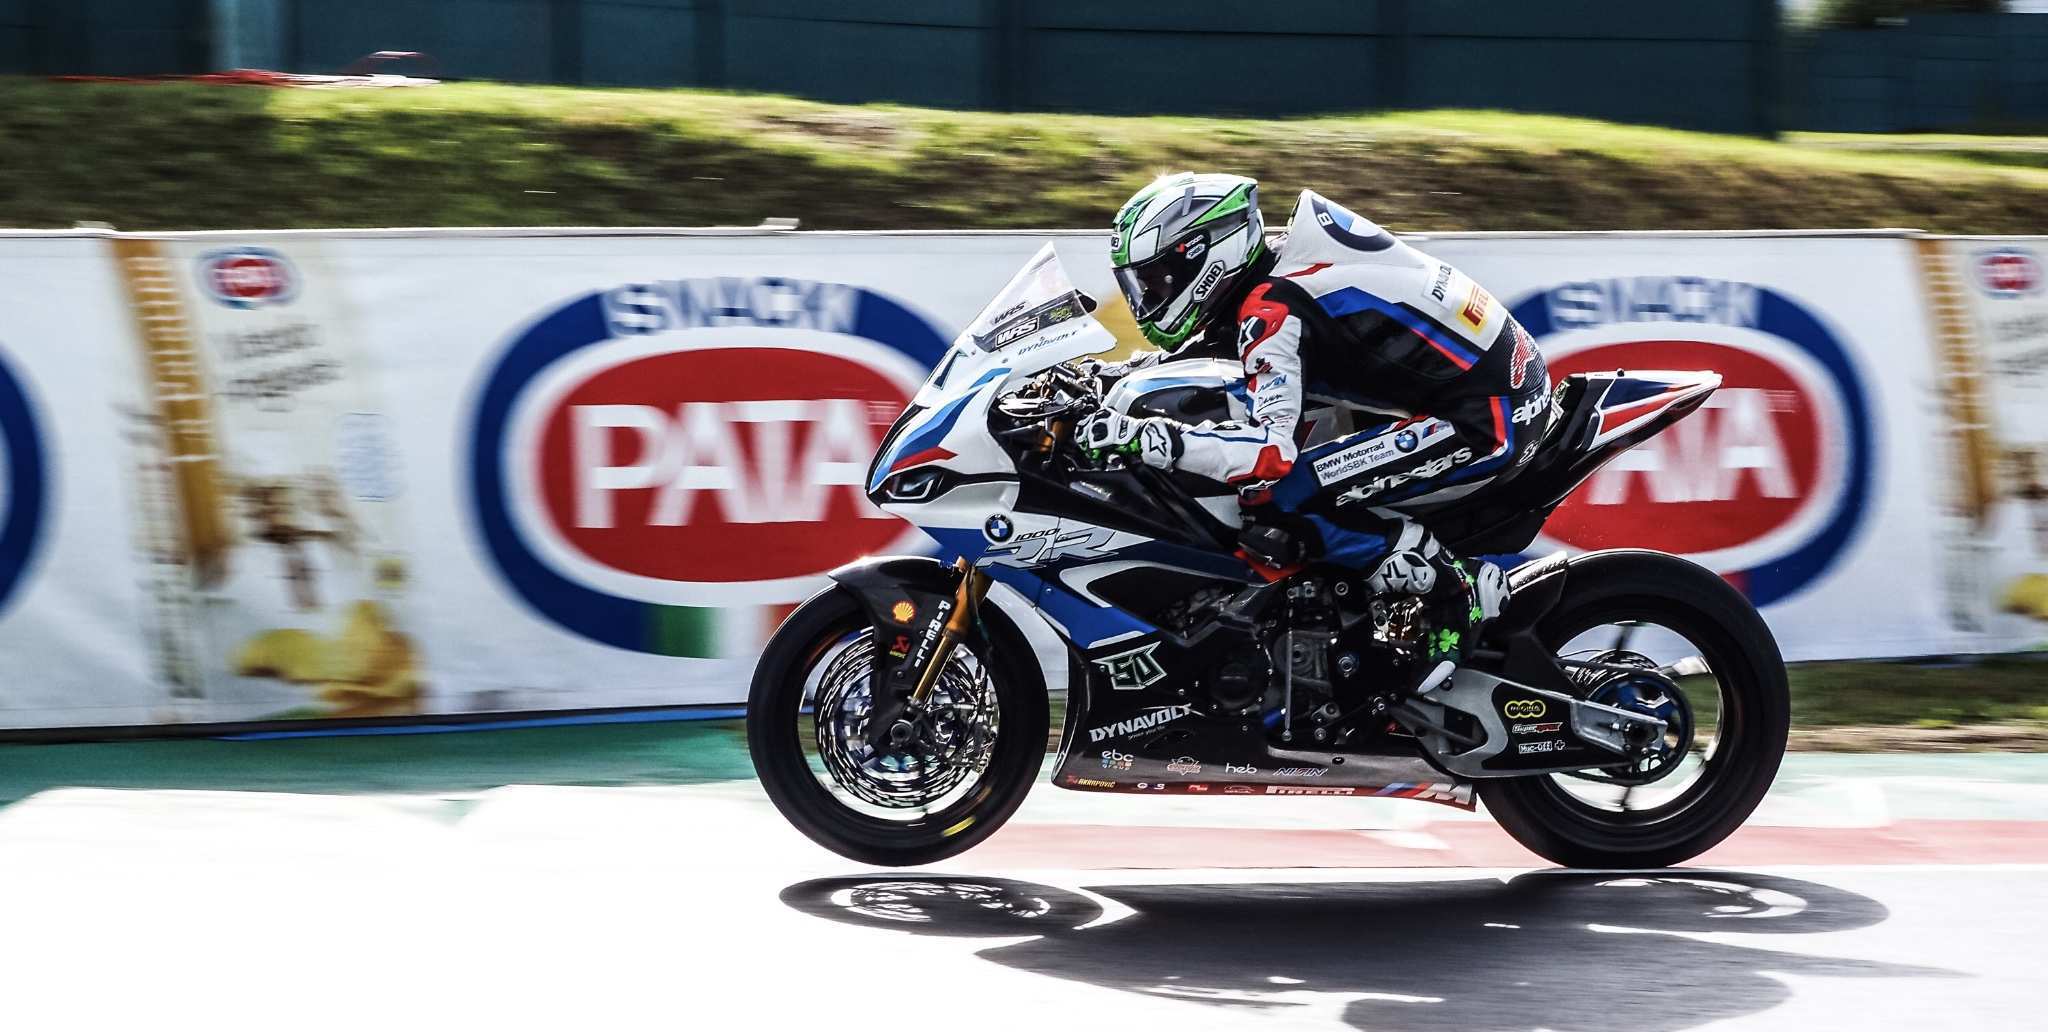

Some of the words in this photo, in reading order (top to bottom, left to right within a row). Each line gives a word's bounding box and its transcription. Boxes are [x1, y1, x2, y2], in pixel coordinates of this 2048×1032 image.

[1195, 265, 1222, 298] SHOEI
[997, 318, 1038, 346] WRS
[1316, 456, 1341, 472] BMW
[1343, 441, 1385, 462] Motorrad
[1583, 388, 1801, 505] ATA
[570, 398, 900, 529] PATA
[1321, 455, 1368, 480] WorldSBK
[1370, 449, 1395, 463] Team
[914, 600, 951, 668] PIRELLI
[1089, 703, 1191, 743] DYNAVOLT
[1101, 750, 1134, 762] ebc
[1520, 741, 1552, 753] Muc-Off
[1225, 763, 1258, 774] heb
